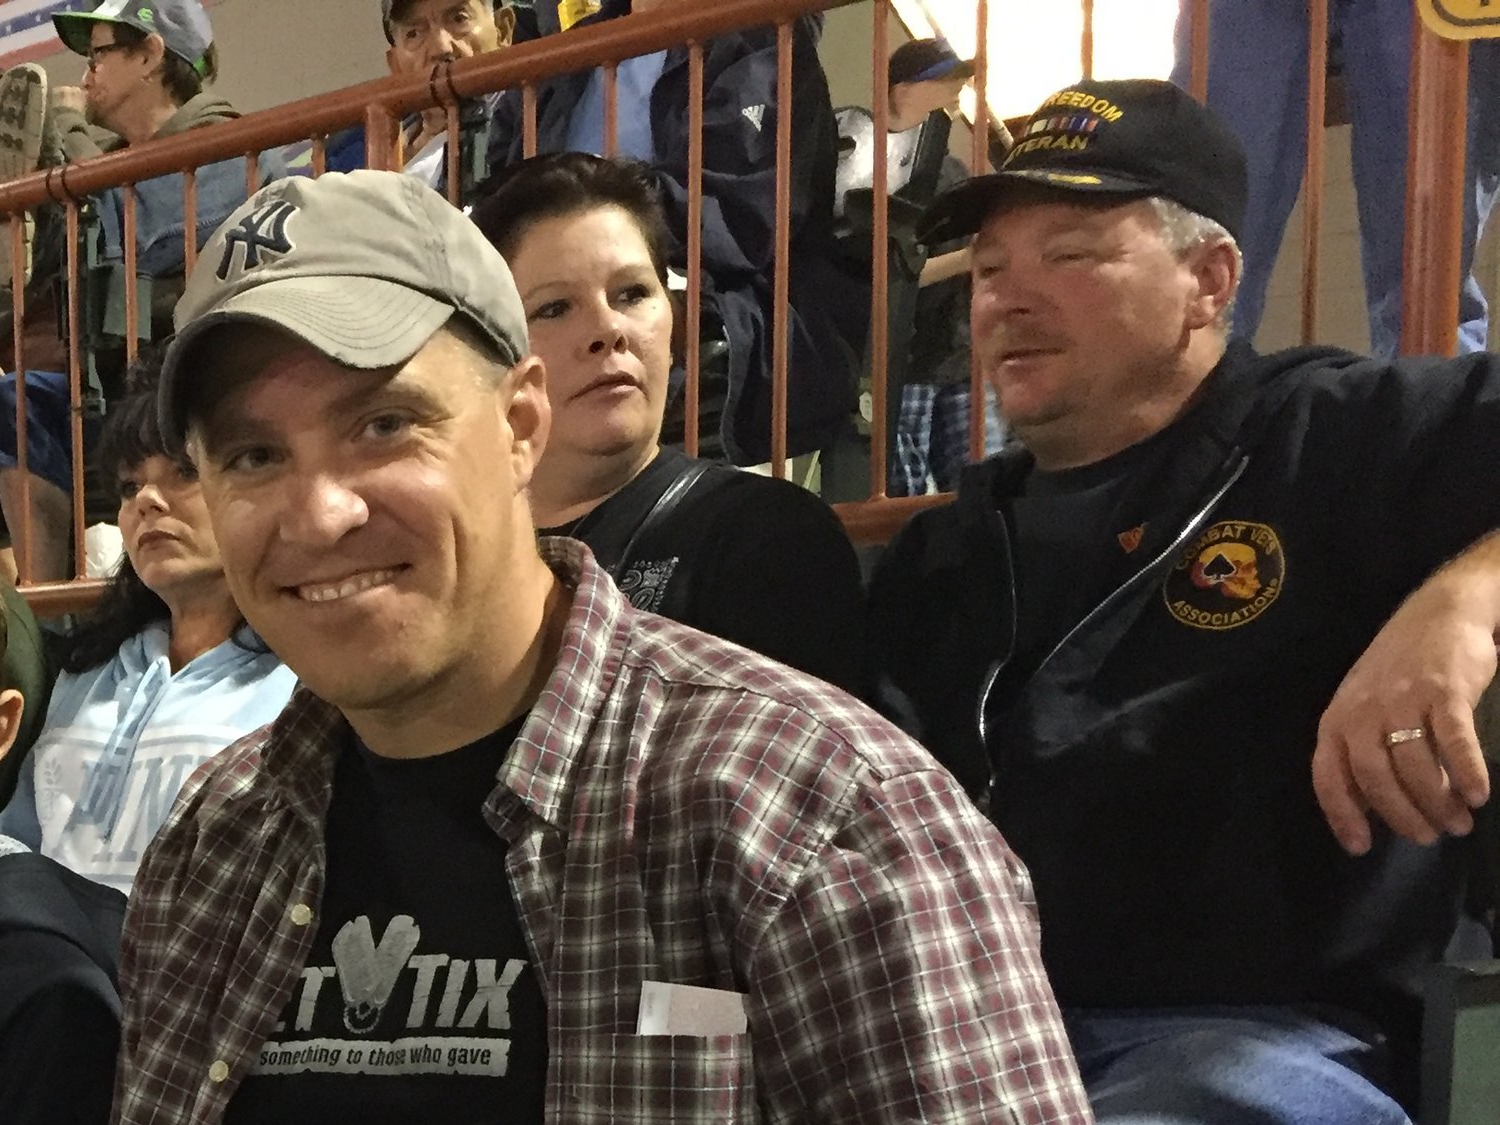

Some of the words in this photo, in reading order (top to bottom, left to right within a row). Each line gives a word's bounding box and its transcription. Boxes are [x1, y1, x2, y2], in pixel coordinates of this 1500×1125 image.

[405, 953, 528, 1030] TIX
[260, 1045, 342, 1067] something
[347, 1048, 363, 1065] to
[368, 1047, 406, 1066] those
[410, 1043, 442, 1064] who
[447, 1047, 492, 1067] gave
